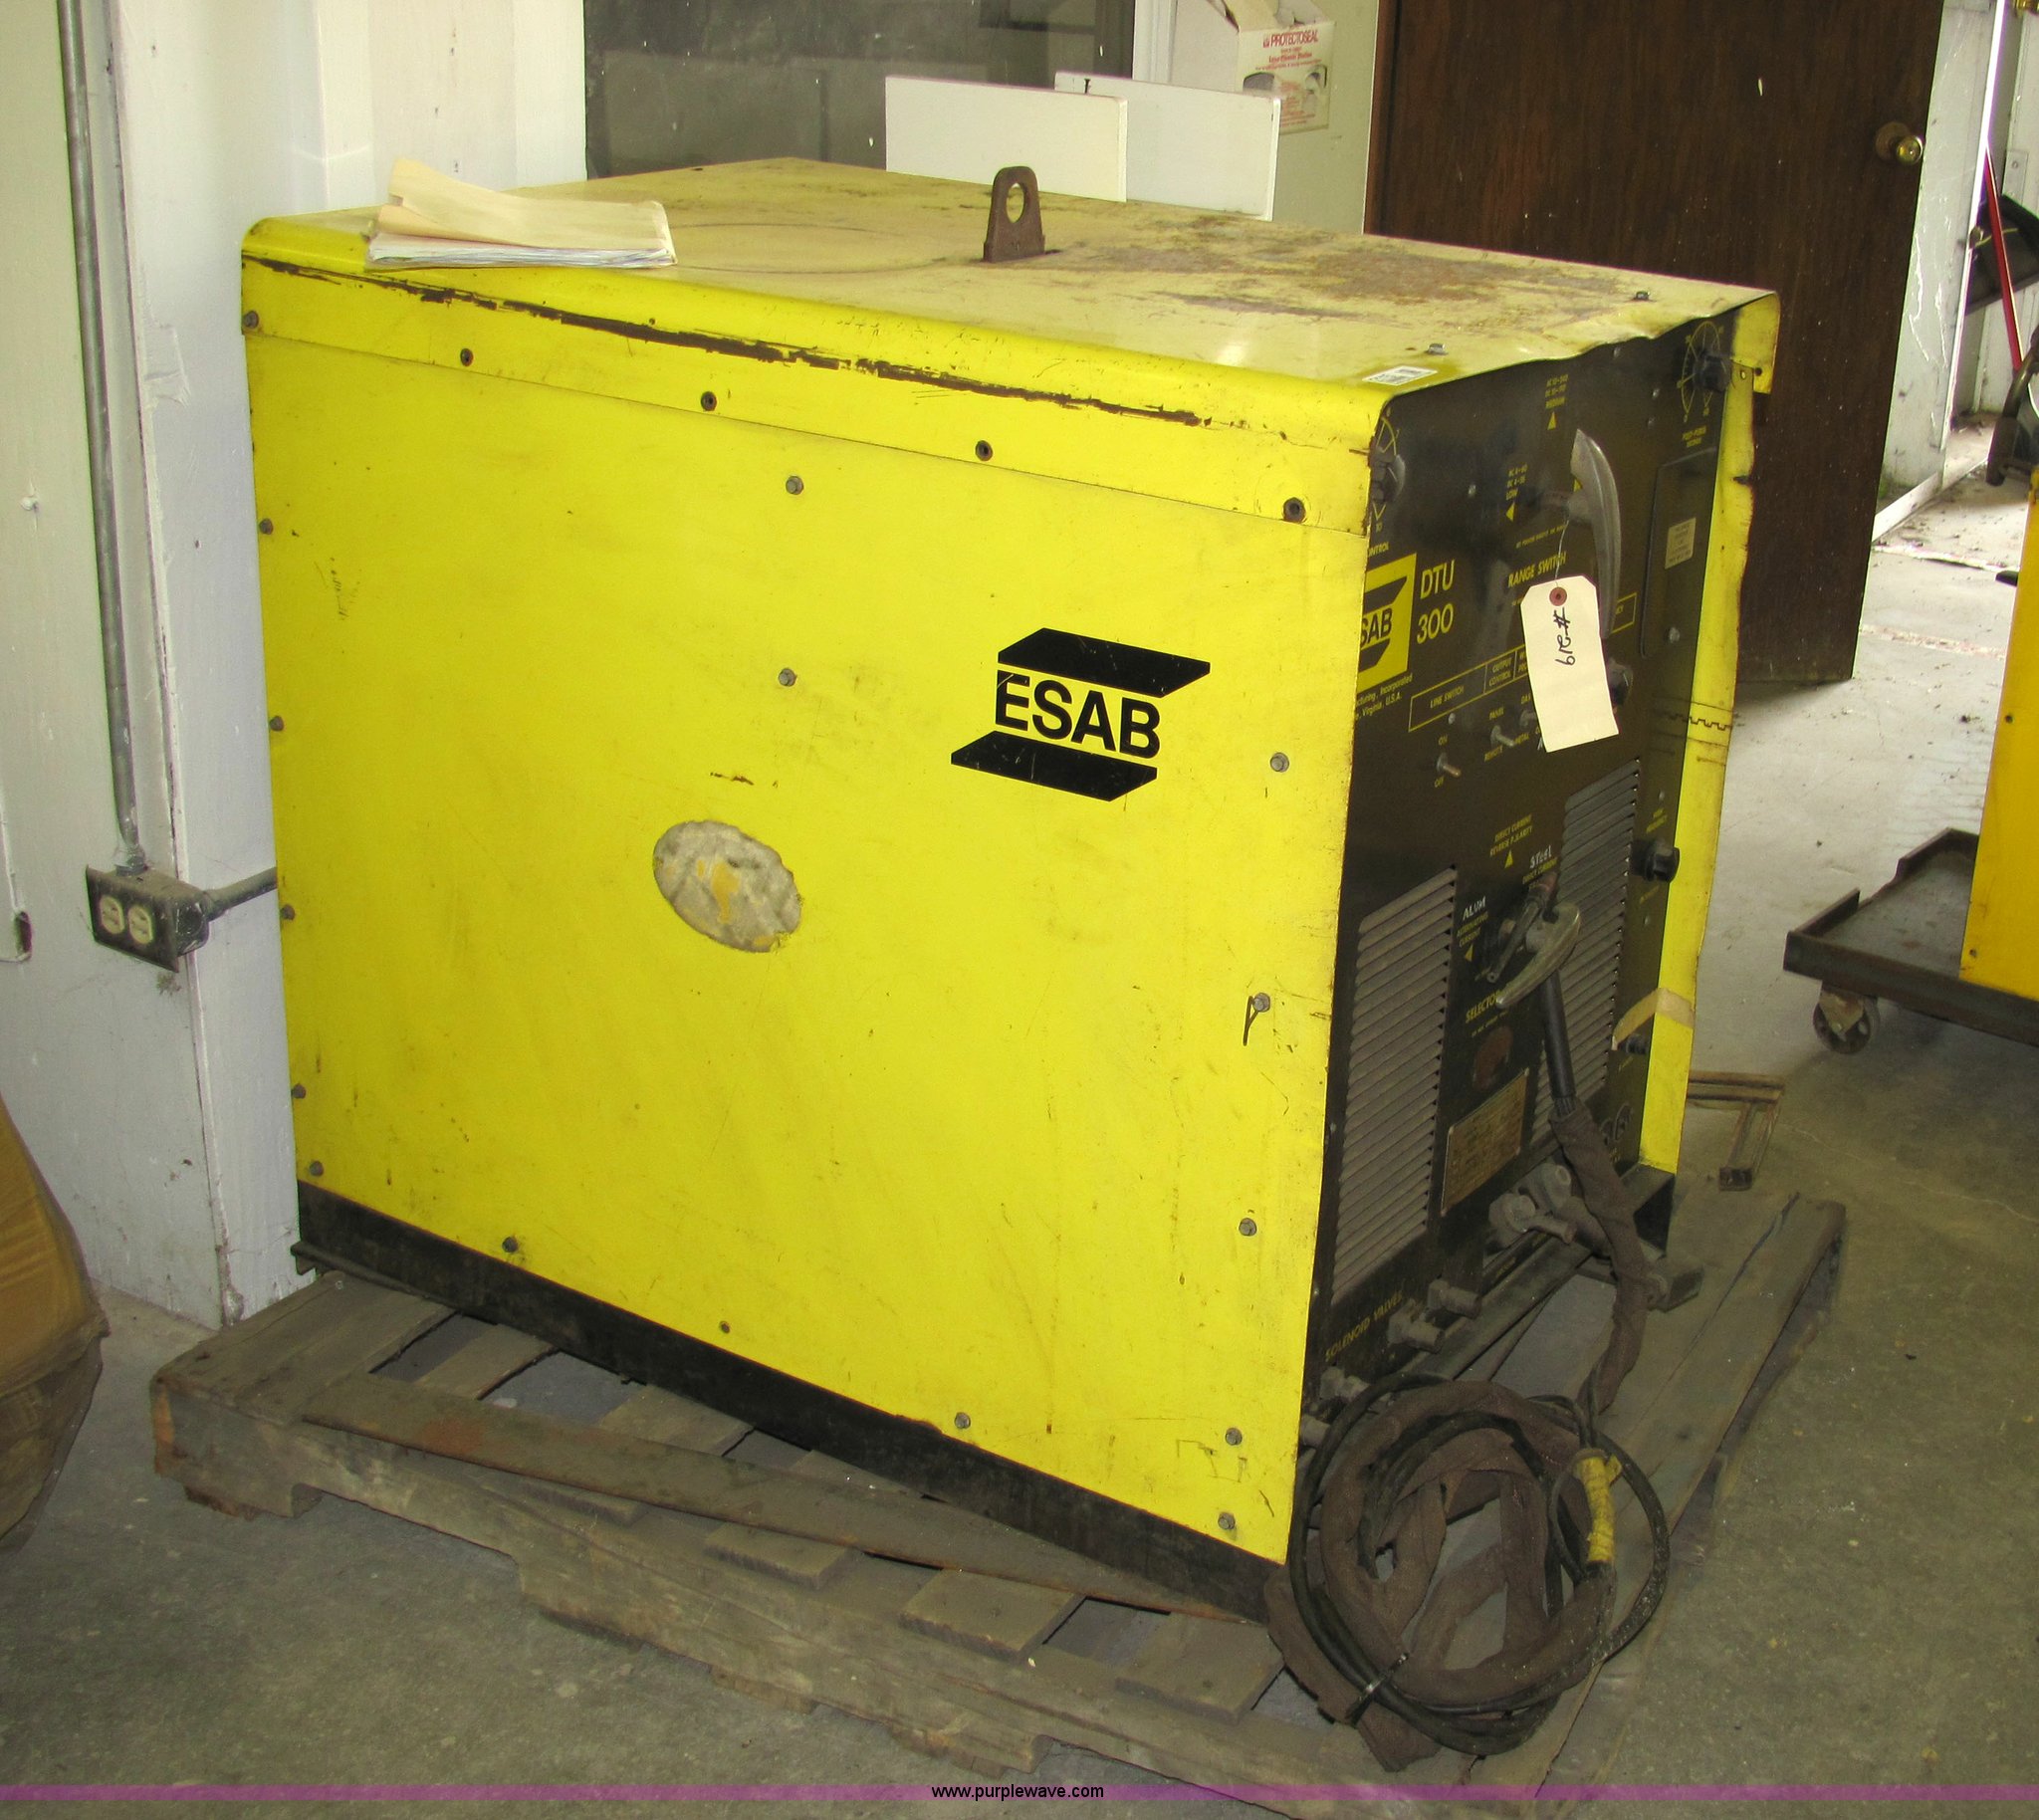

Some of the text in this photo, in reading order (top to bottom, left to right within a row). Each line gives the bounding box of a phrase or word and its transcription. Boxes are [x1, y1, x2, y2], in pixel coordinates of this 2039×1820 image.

[1270, 30, 1318, 47] PROTECTOSEAL
[1420, 560, 1455, 599] DTU
[1507, 551, 1567, 588] RANGE SWITCH
[1417, 602, 1455, 645] 300
[1380, 673, 1413, 696] Incorporated
[1488, 670, 1512, 687] CONTROL
[1430, 685, 1465, 709] LINE SWITCH
[996, 669, 1161, 759] ESAB
